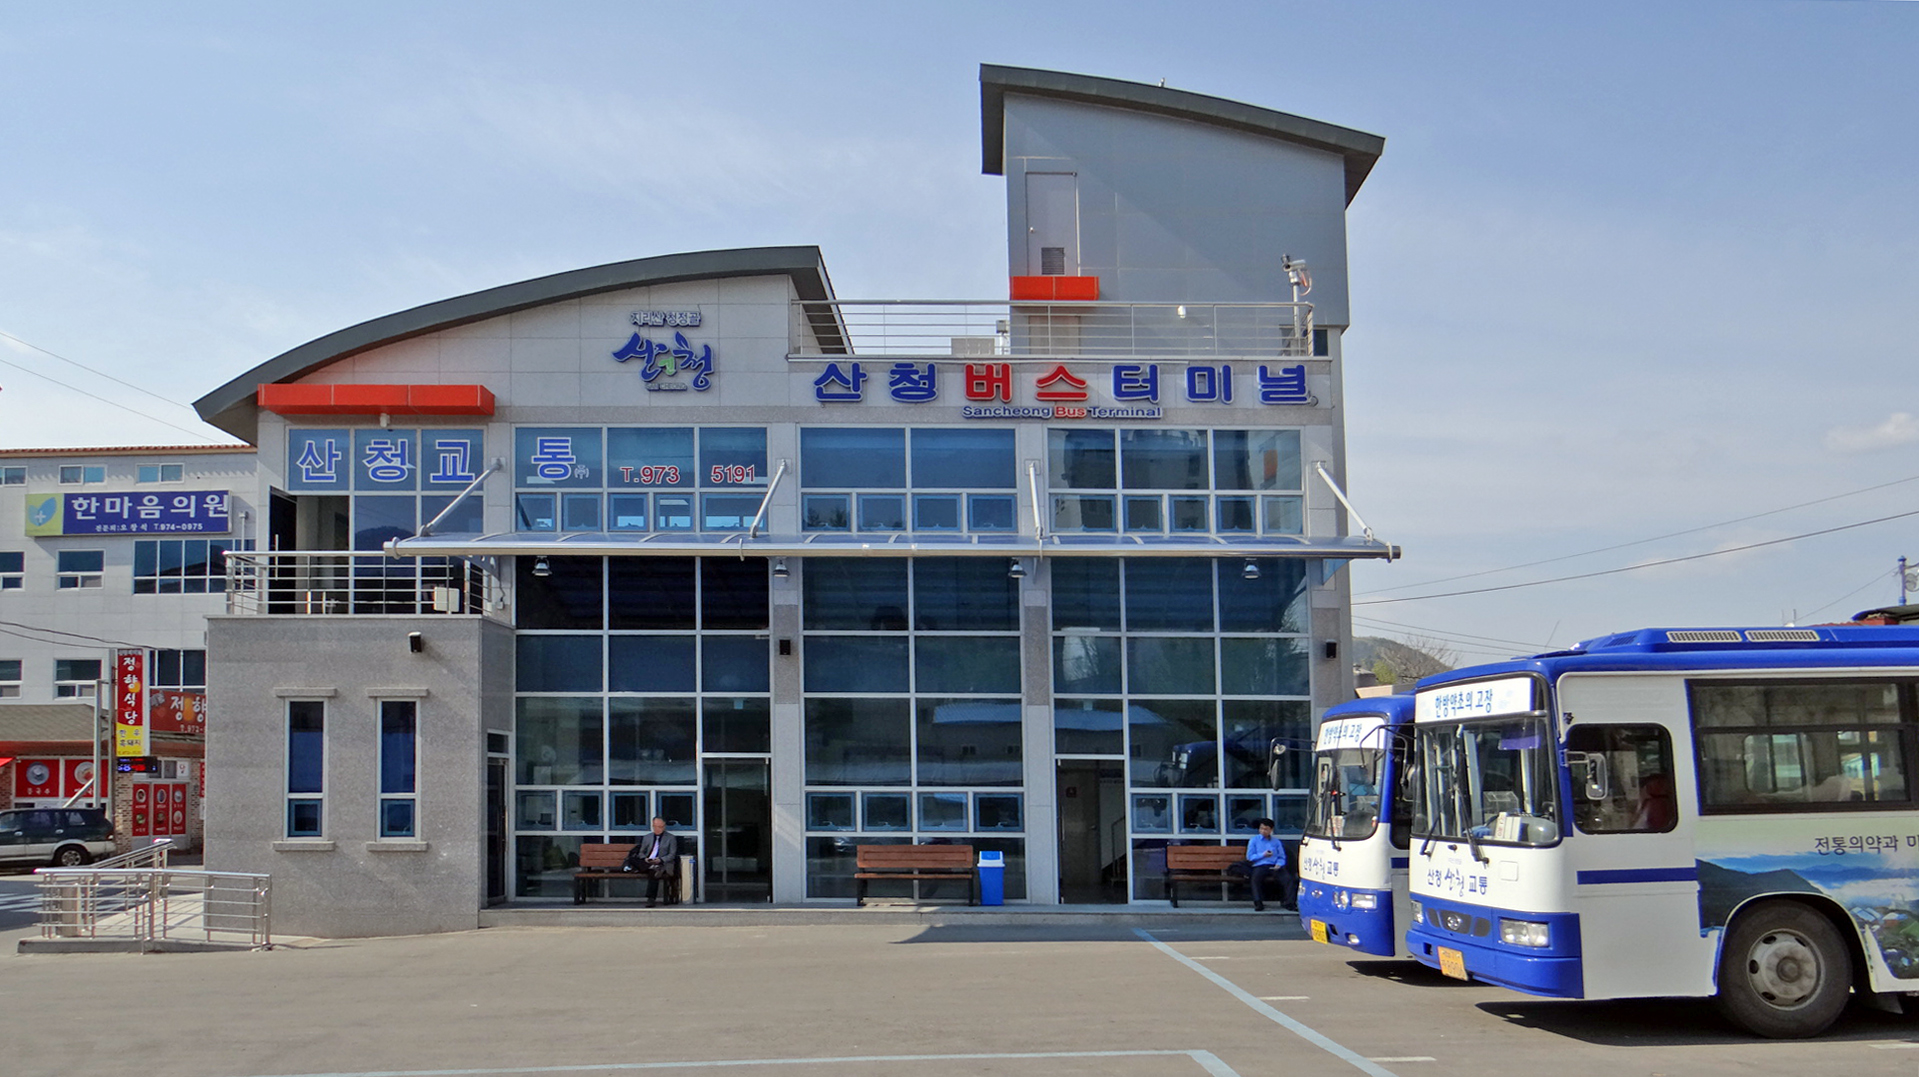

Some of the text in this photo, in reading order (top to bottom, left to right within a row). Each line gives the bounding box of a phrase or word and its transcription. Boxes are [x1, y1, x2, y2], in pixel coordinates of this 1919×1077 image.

[612, 331, 714, 390] 산청
[962, 406, 1163, 419] Sancheong Bus Terminal
[711, 463, 755, 483] 5191
[71, 494, 228, 520] 한마음의원
[123, 657, 138, 725] 정향식당
[1435, 688, 1493, 718] 한방약초의 고장
[1814, 834, 1899, 856] 전통의약과
[1427, 869, 1442, 888] 산청
[1468, 875, 1488, 895] 교통
